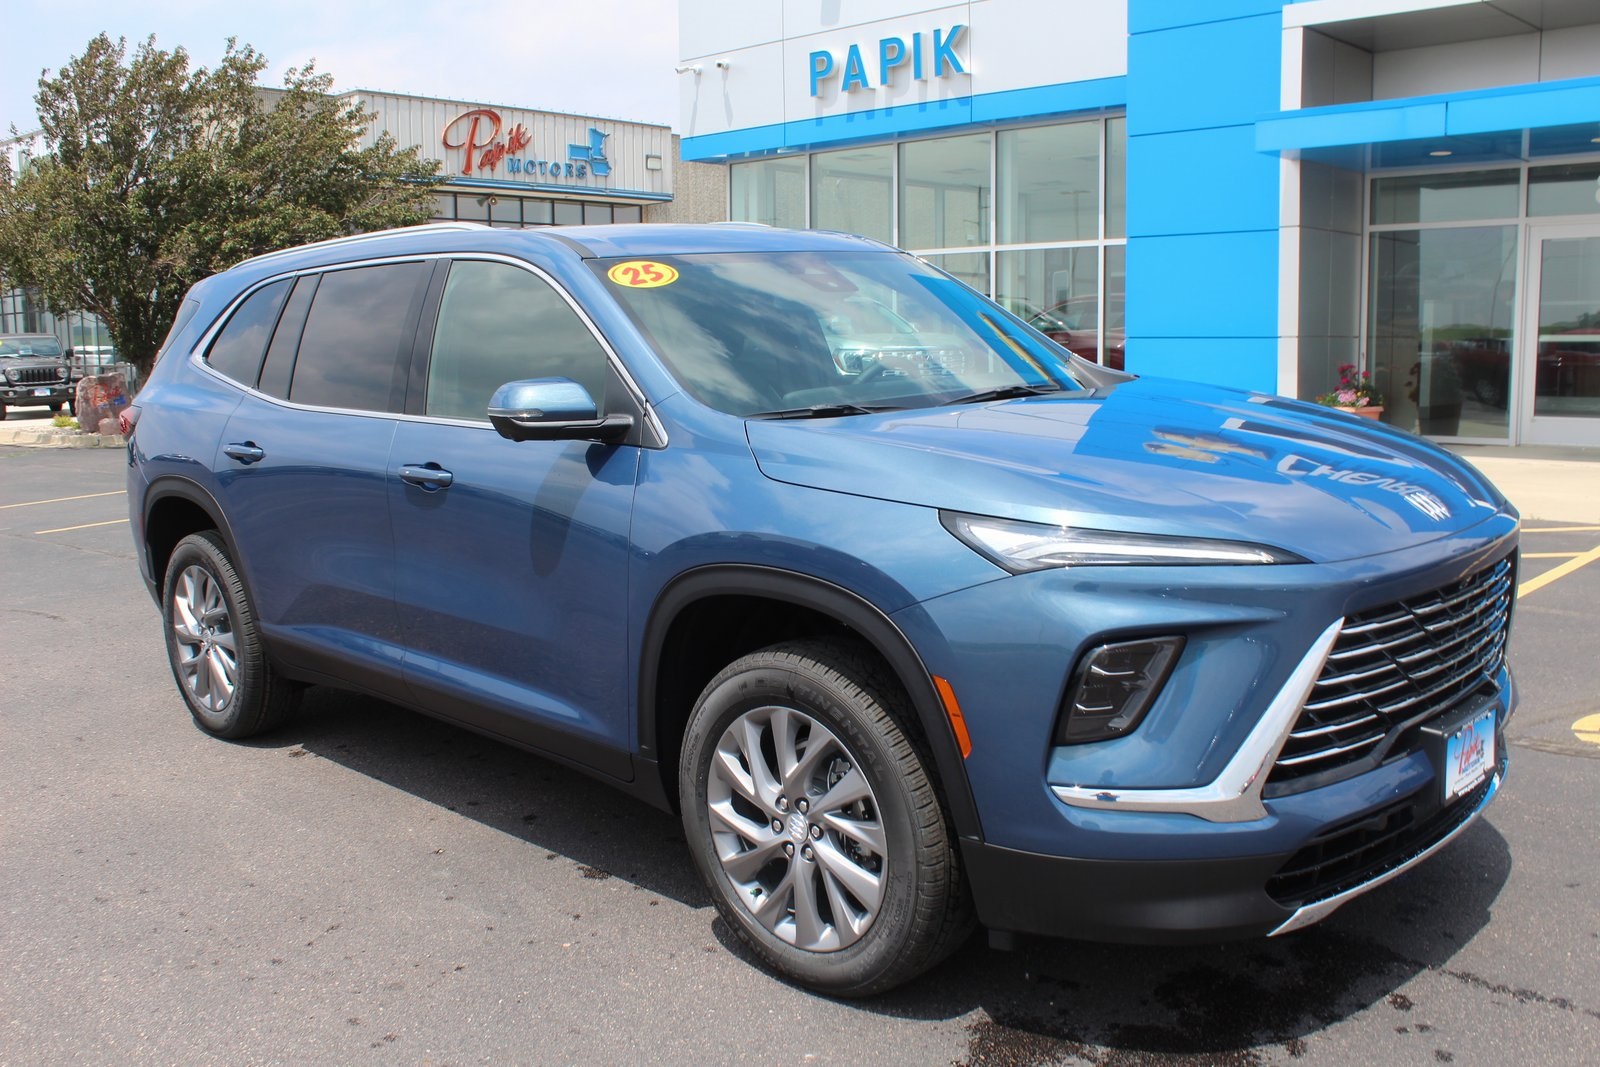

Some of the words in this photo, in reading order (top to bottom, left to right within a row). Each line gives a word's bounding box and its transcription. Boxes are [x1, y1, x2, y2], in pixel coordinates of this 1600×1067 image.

[809, 25, 970, 97] PAPIK
[442, 109, 532, 175] Papik
[507, 157, 587, 179] MOTORS
[621, 263, 664, 285] 25
